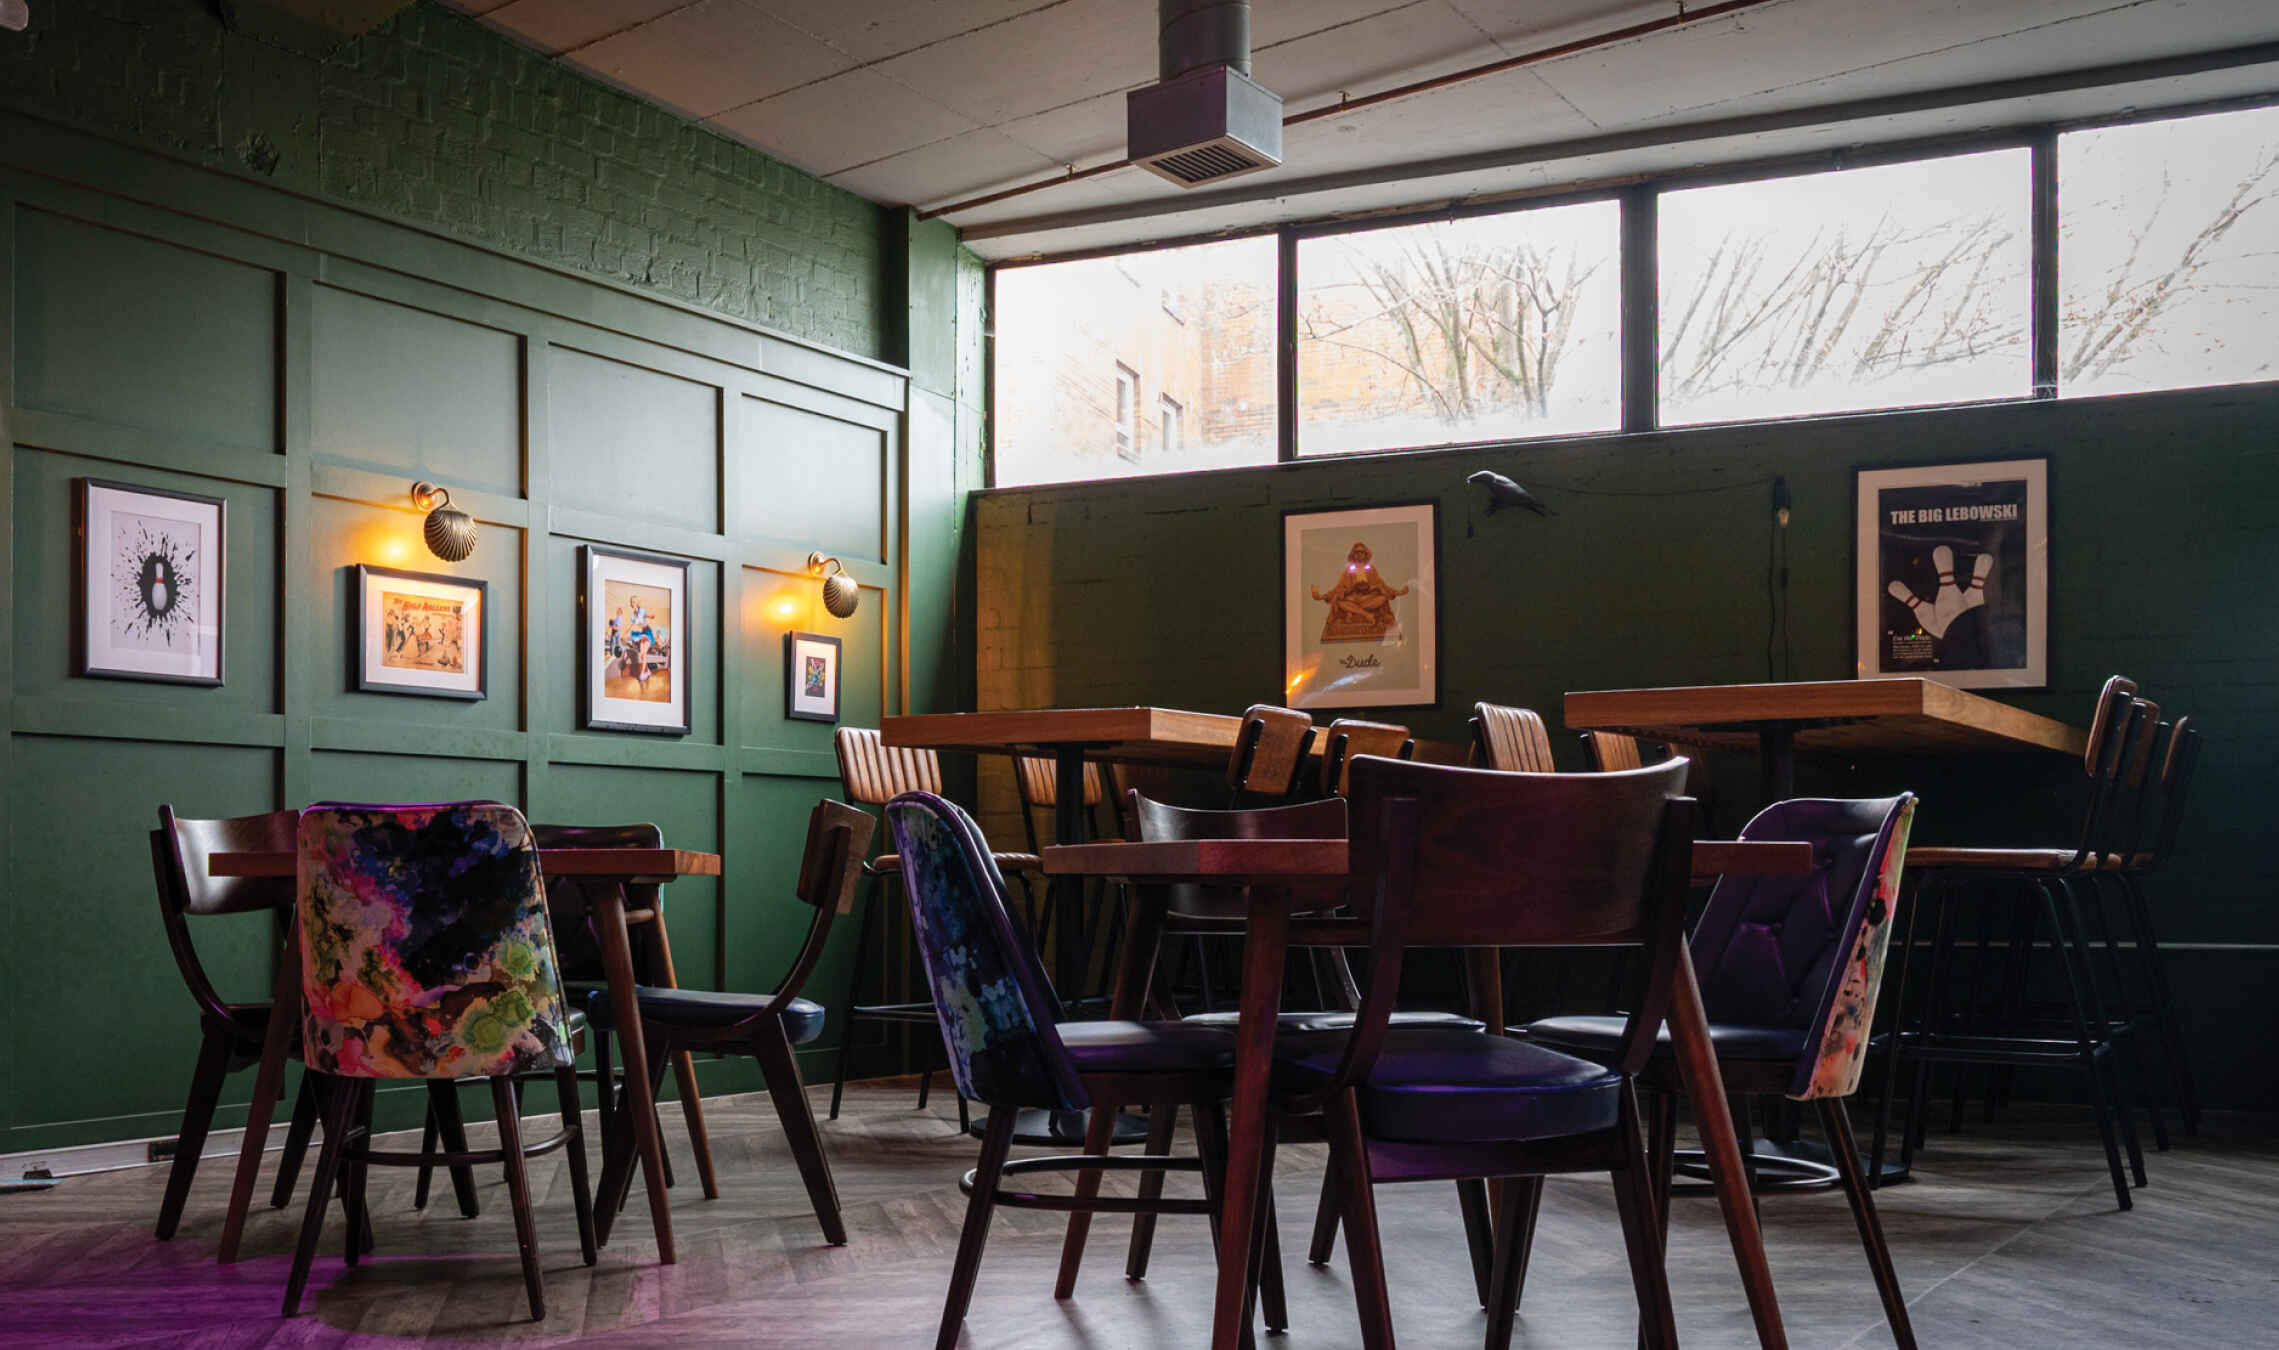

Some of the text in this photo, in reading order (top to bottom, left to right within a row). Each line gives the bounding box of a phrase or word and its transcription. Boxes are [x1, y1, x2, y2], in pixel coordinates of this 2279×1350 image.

[1890, 504, 2018, 525] THE BIG LEBOWSKI
